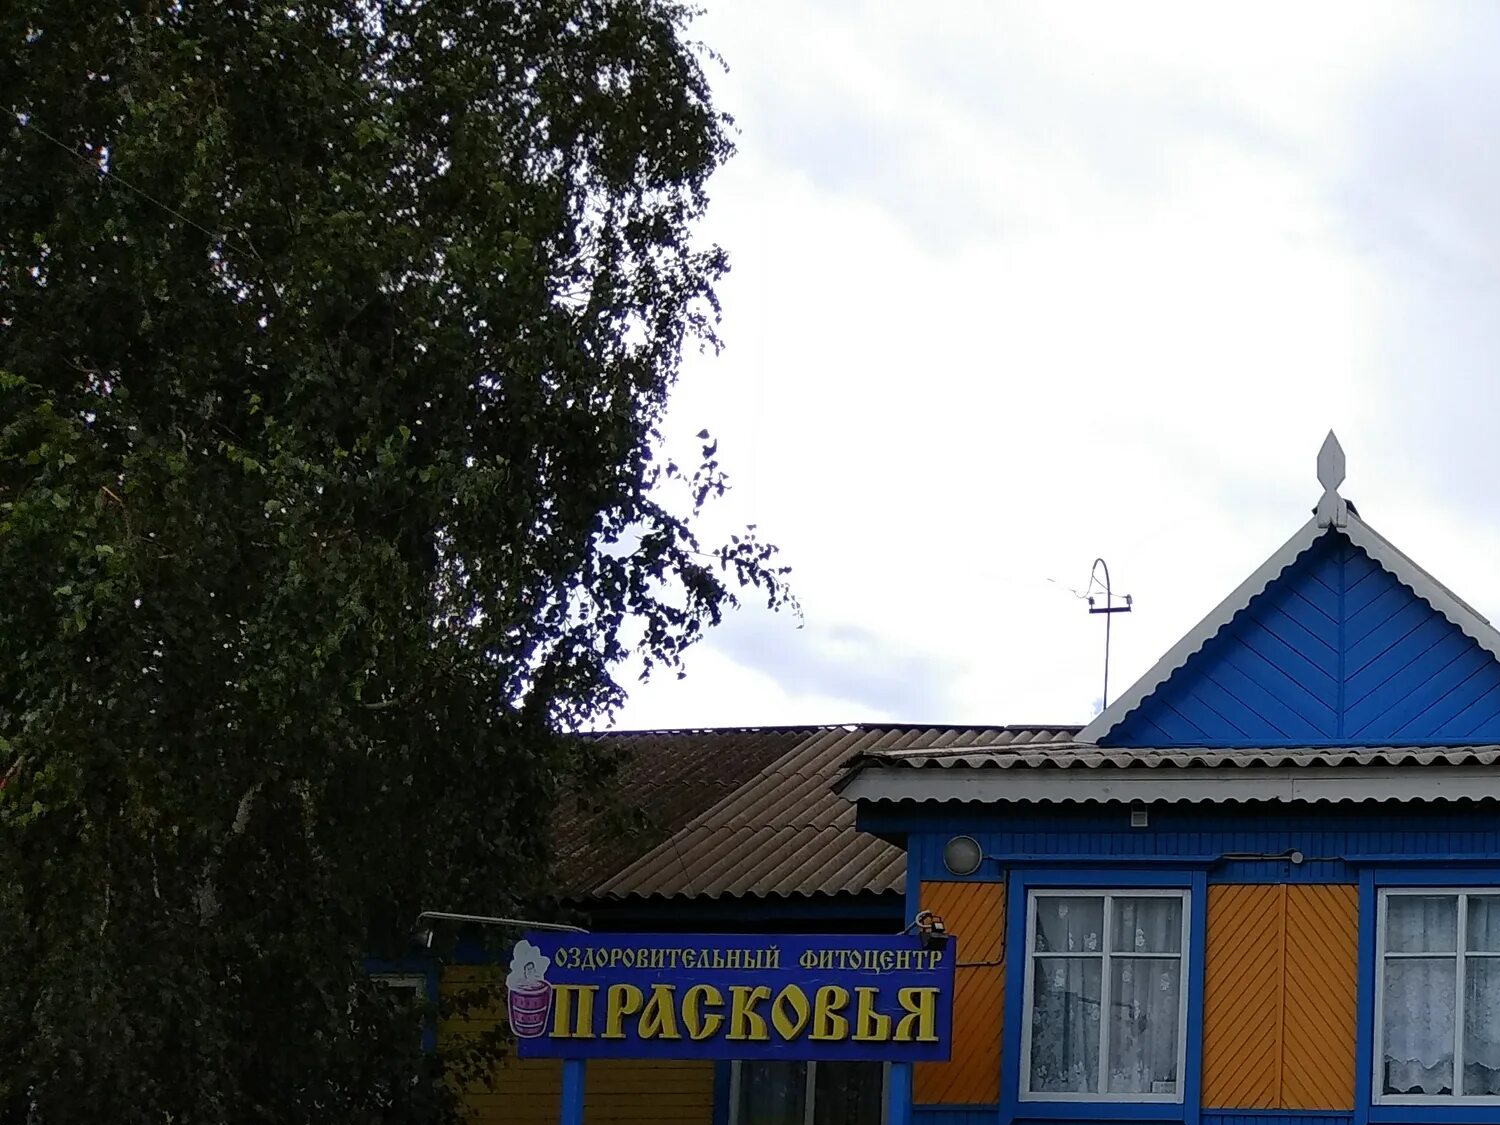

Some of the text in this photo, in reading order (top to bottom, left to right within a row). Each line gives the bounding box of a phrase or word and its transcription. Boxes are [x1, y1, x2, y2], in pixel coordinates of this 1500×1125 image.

[554, 944, 943, 974] ОЗДОРОВИТЕЛЬНЫЙ ФИТОЦЕНТР
[548, 984, 941, 1042] ПРАСКОВЬЯ
